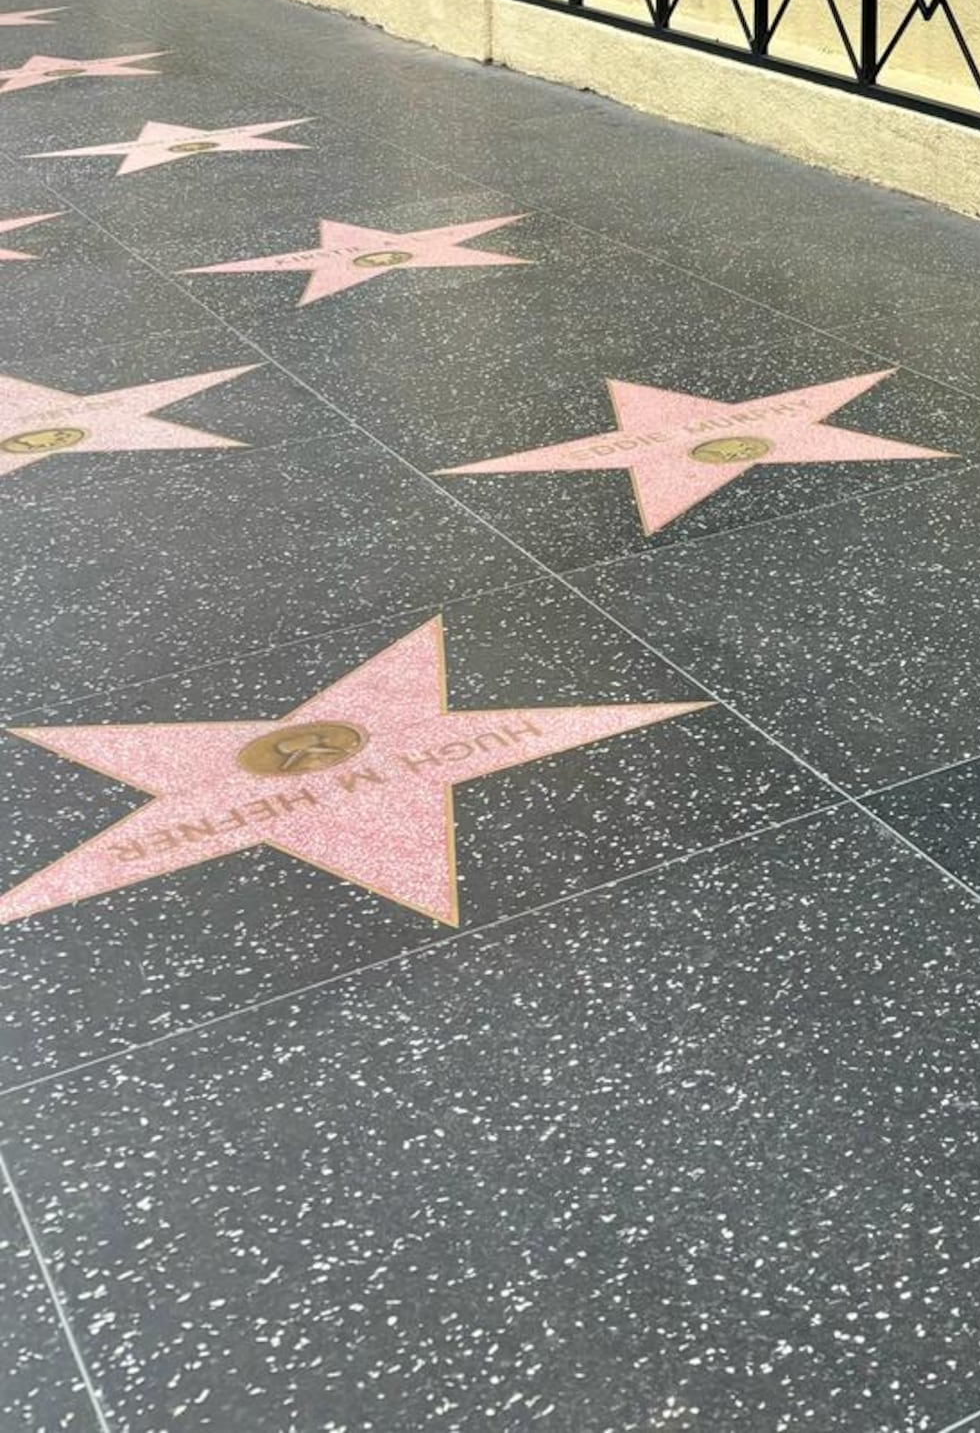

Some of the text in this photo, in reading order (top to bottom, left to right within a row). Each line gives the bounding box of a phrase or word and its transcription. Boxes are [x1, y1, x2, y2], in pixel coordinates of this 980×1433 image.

[568, 399, 812, 462] EDDIE MURPHY
[107, 720, 544, 863] HUGH M HEFNER
